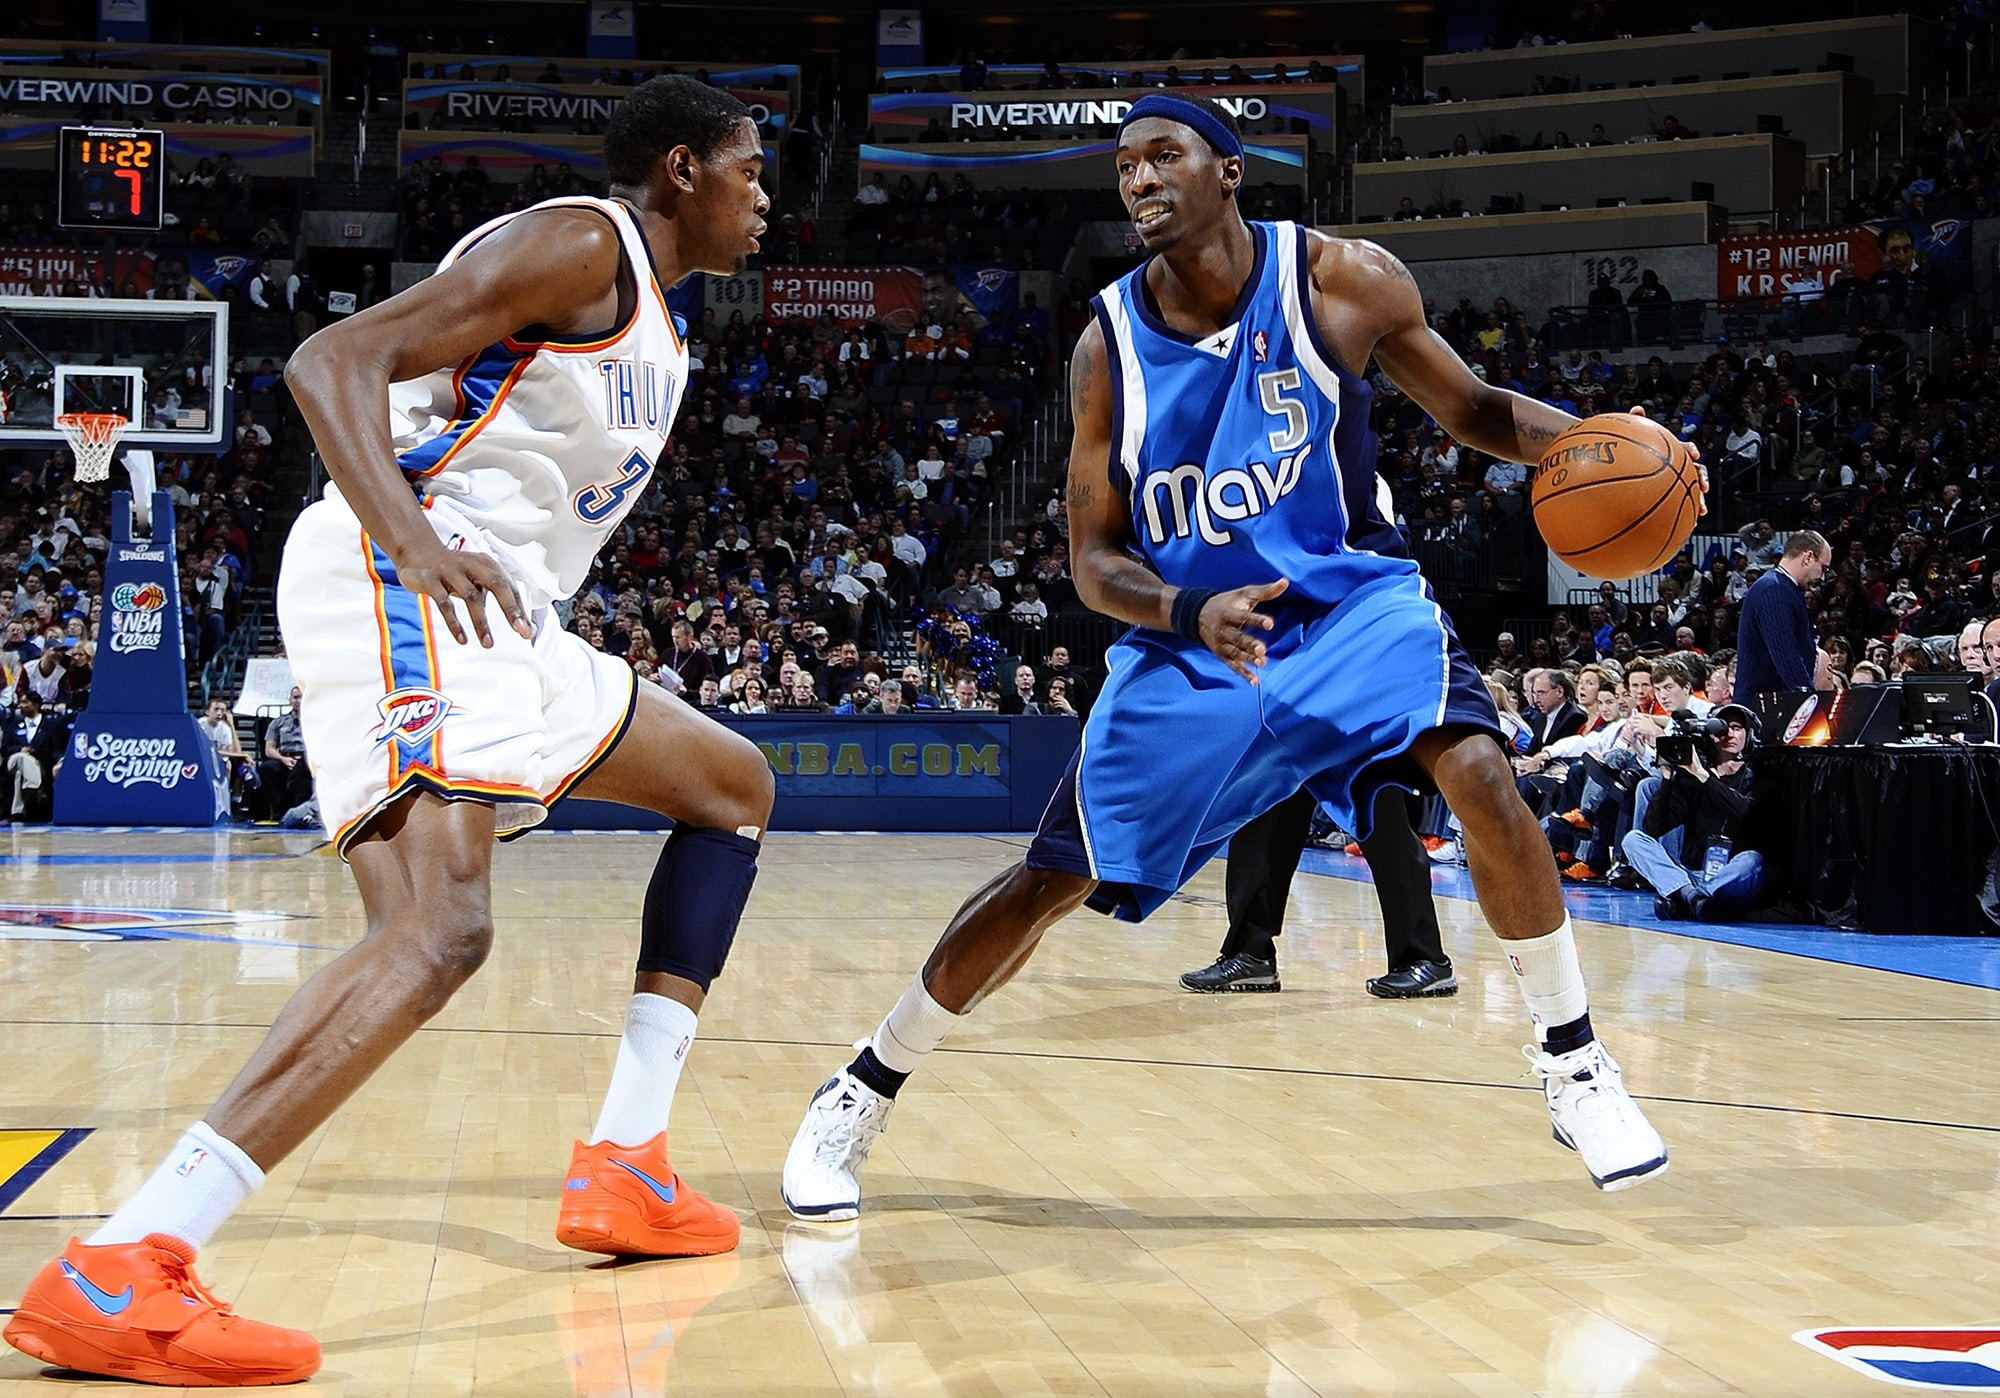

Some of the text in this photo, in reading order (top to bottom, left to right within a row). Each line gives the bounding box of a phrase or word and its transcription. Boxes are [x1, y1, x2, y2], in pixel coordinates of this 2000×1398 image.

[163, 83, 292, 110] CASINO
[951, 100, 1133, 128] RIVERWIND
[82, 140, 152, 168] 11:22
[114, 169, 141, 215] 7
[1728, 241, 1850, 272] #12 NENAD
[710, 278, 760, 304] 101
[770, 278, 874, 302] #2 THABO
[1258, 366, 1309, 453] 5
[1536, 441, 1618, 481] SPALDIN
[573, 446, 655, 525] 3
[118, 549, 165, 562] SPALDING
[123, 611, 162, 633] NBA
[110, 632, 162, 653] Cares
[376, 698, 437, 741] OKC
[87, 732, 176, 760] Season
[757, 742, 1001, 776] NBA.COM
[84, 756, 184, 789] of Giving
